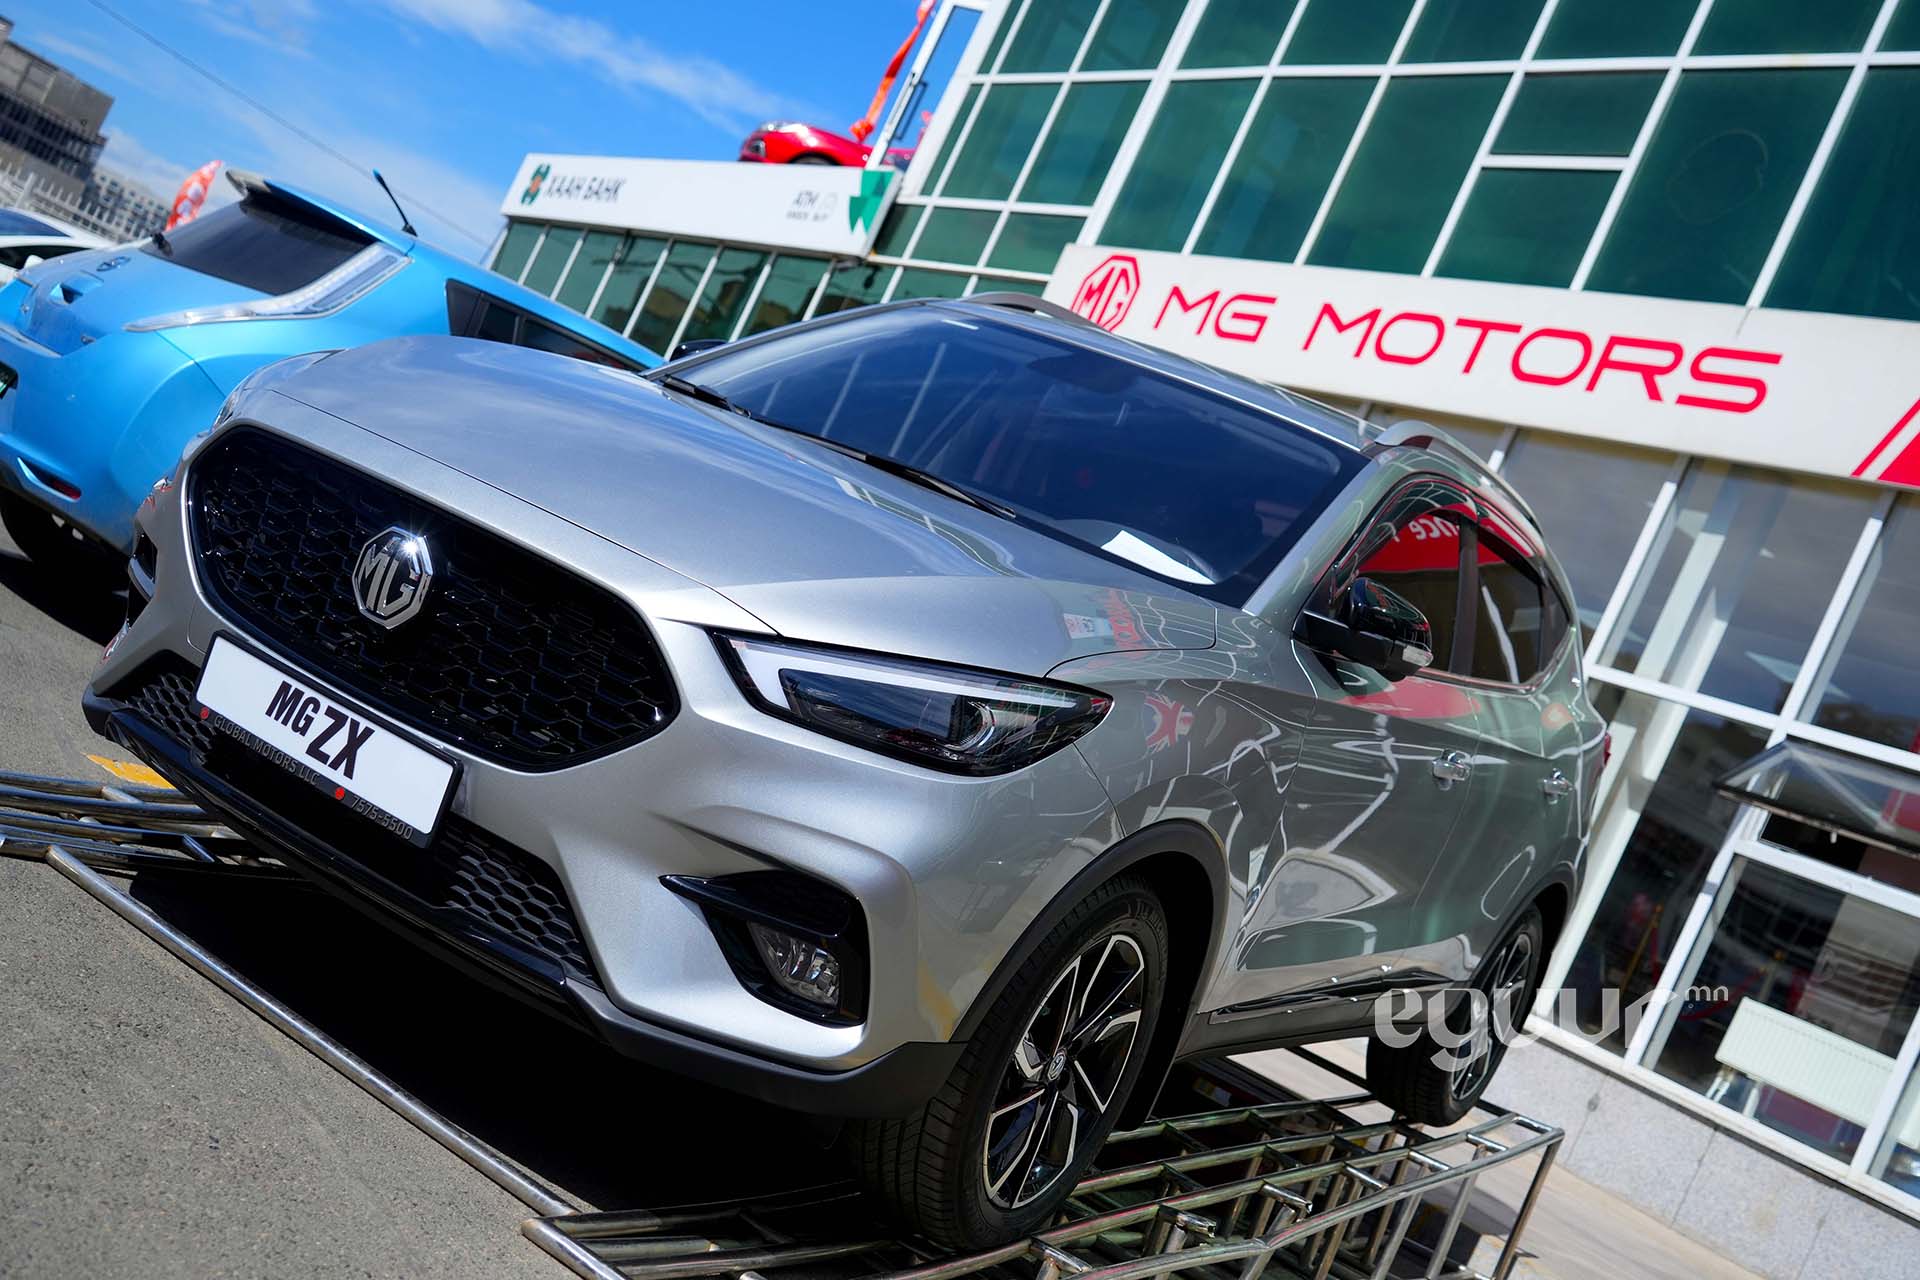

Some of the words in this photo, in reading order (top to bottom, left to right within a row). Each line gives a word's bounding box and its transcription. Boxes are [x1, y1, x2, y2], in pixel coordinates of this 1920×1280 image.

[1154, 285, 1278, 344] MG
[1303, 303, 1783, 414] MOTORS
[355, 531, 427, 622] MG
[214, 715, 251, 746] GLOBAL
[252, 739, 298, 773] MOTORS
[298, 765, 320, 785] LLC
[351, 795, 413, 839] 7575-5500
